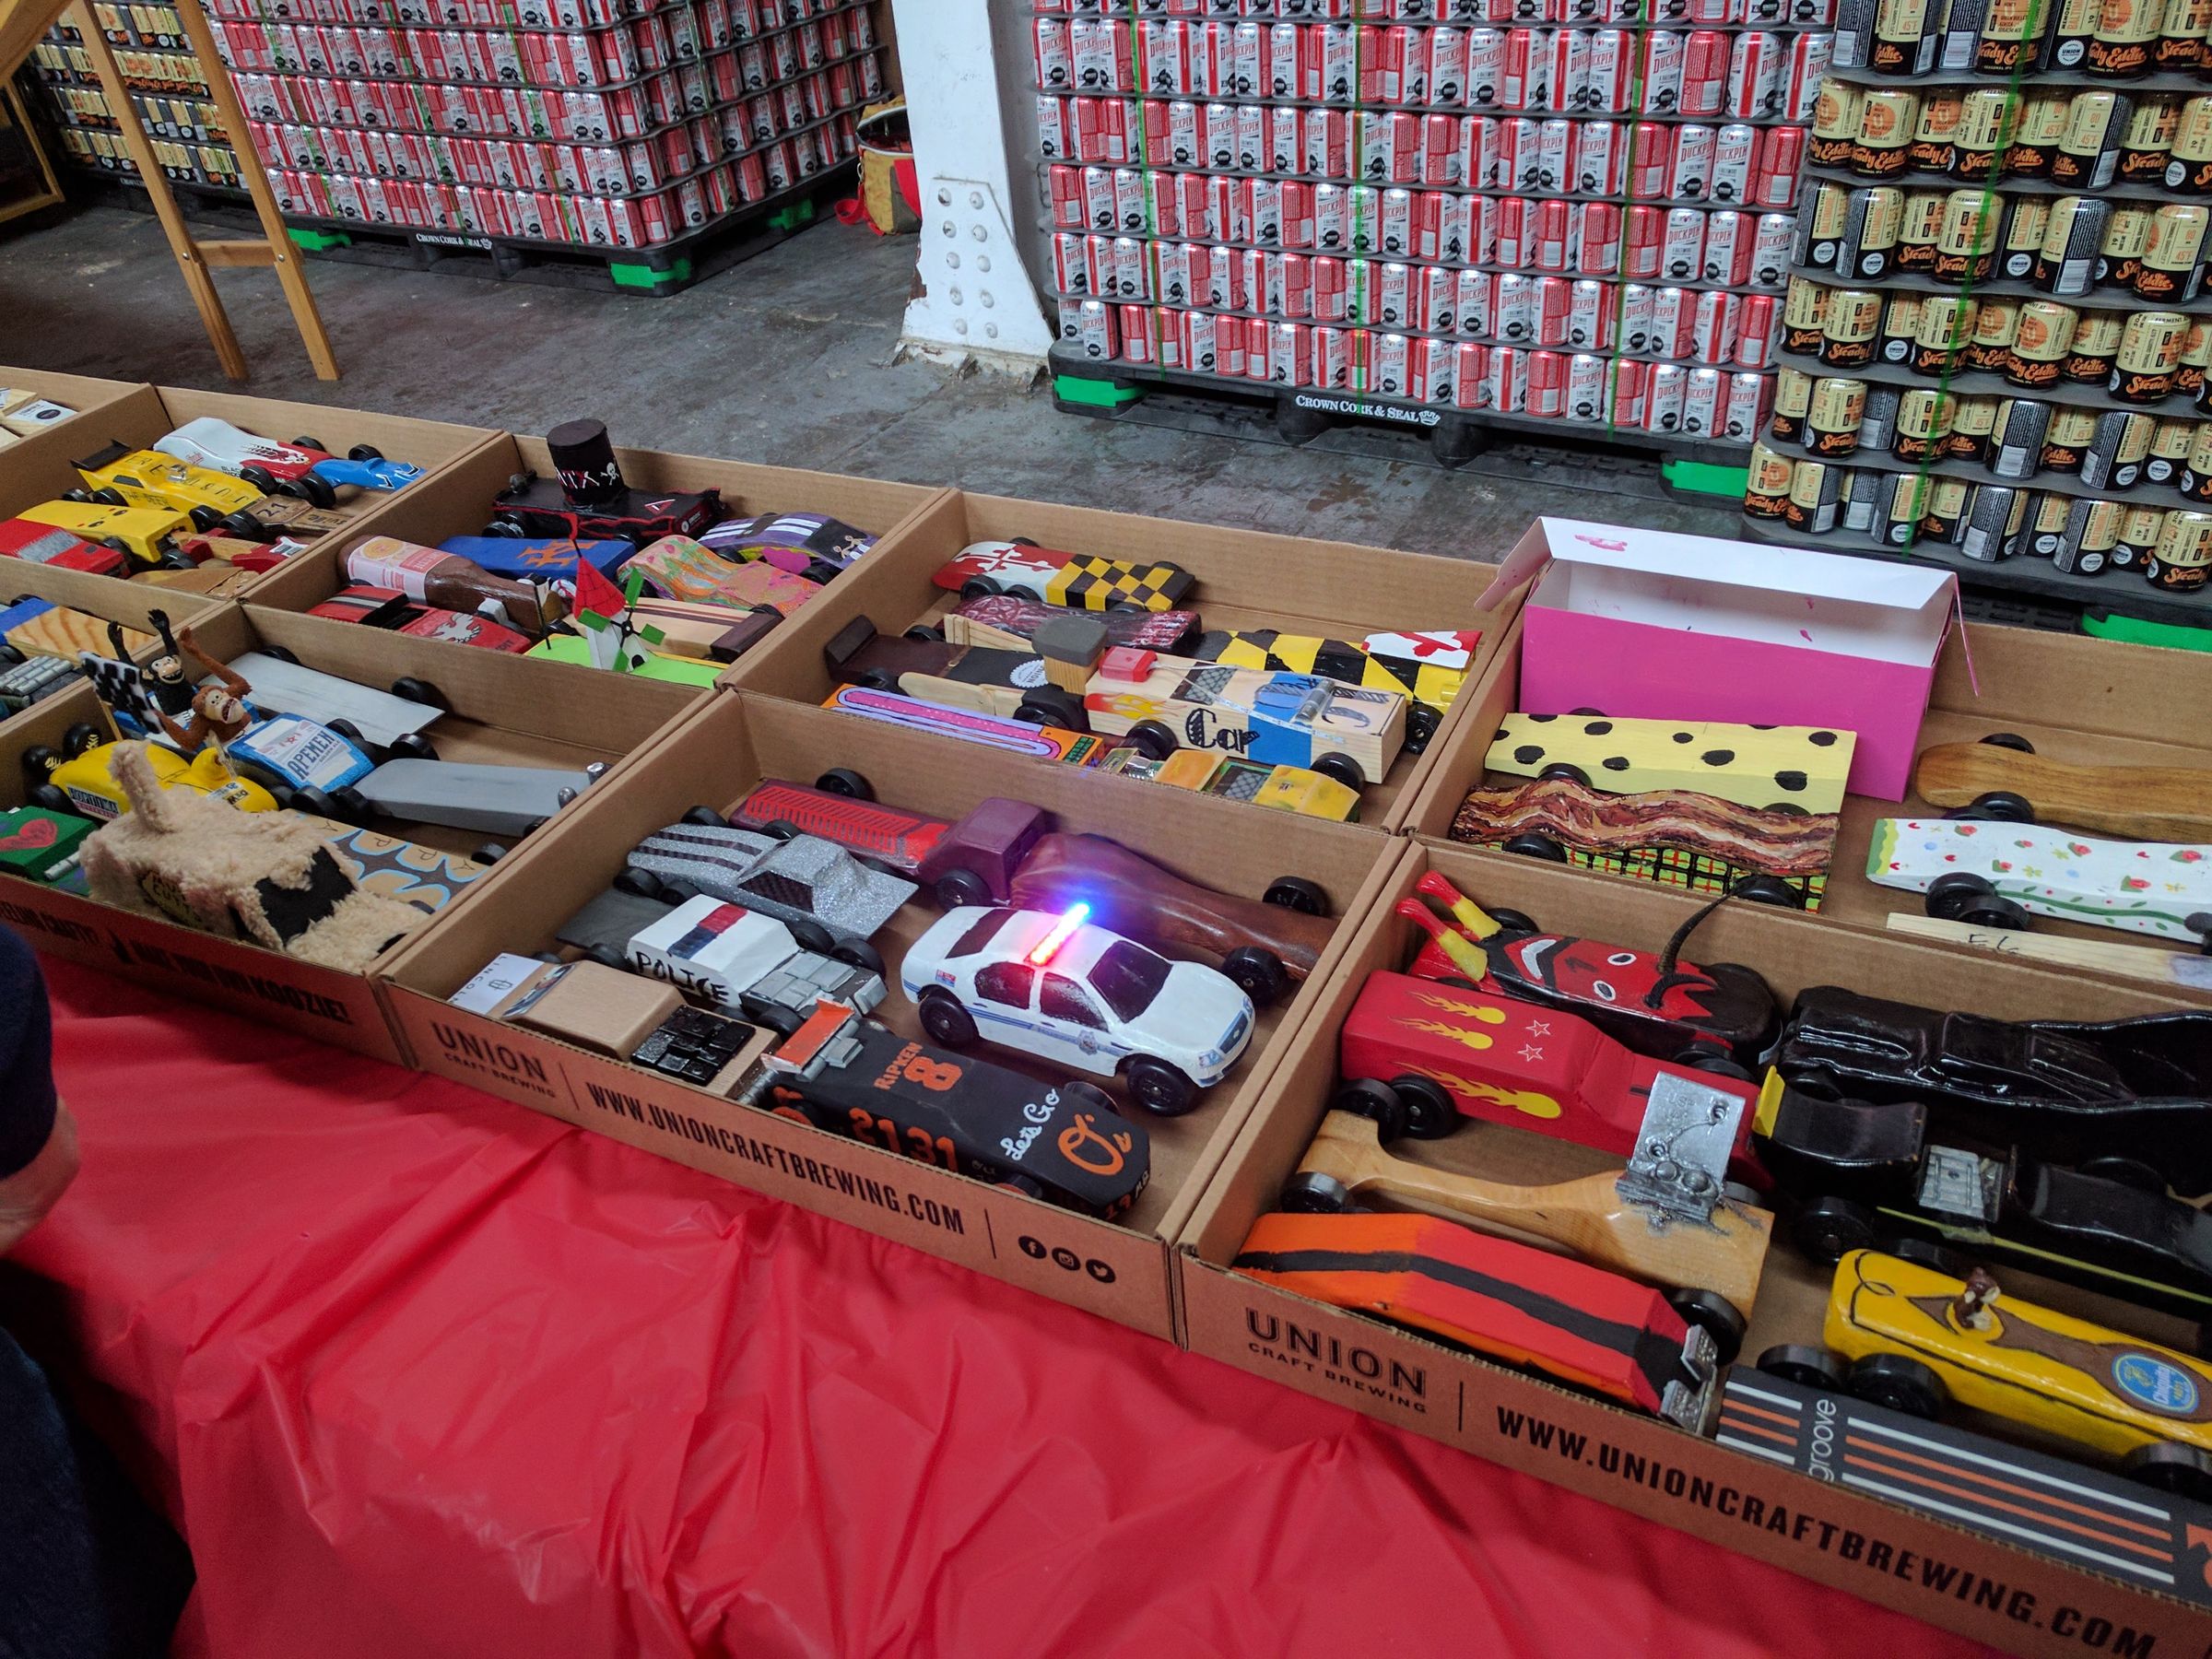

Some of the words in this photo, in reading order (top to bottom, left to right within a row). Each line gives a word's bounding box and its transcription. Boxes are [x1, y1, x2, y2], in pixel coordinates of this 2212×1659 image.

[416, 232, 441, 244] CROWN
[440, 235, 458, 246] CORK
[1296, 394, 1339, 412] CROWN
[1338, 399, 1373, 416] CORK
[1373, 405, 1385, 418] &
[1386, 406, 1419, 423] SEAL
[287, 729, 336, 782] APEMEN
[1184, 706, 1262, 755] Car
[635, 949, 731, 1004] POLICE
[432, 1020, 548, 1084] UNION
[444, 1051, 490, 1075] CRAFT
[491, 1067, 557, 1100] BREWING
[873, 1041, 924, 1092] RIPKEN
[903, 1054, 964, 1092] 8
[585, 1080, 965, 1236] WWW.UNIONCRAFTBREWING.COM
[848, 1106, 959, 1172] 2131
[1245, 1306, 1428, 1398] UNION
[1247, 1342, 1315, 1377] CRAFT
[1324, 1369, 1428, 1415] BREWING
[1806, 1397, 1838, 1484] groove
[1496, 1405, 2158, 1659] WWW.UNIONCRAFTBREWING.COM
